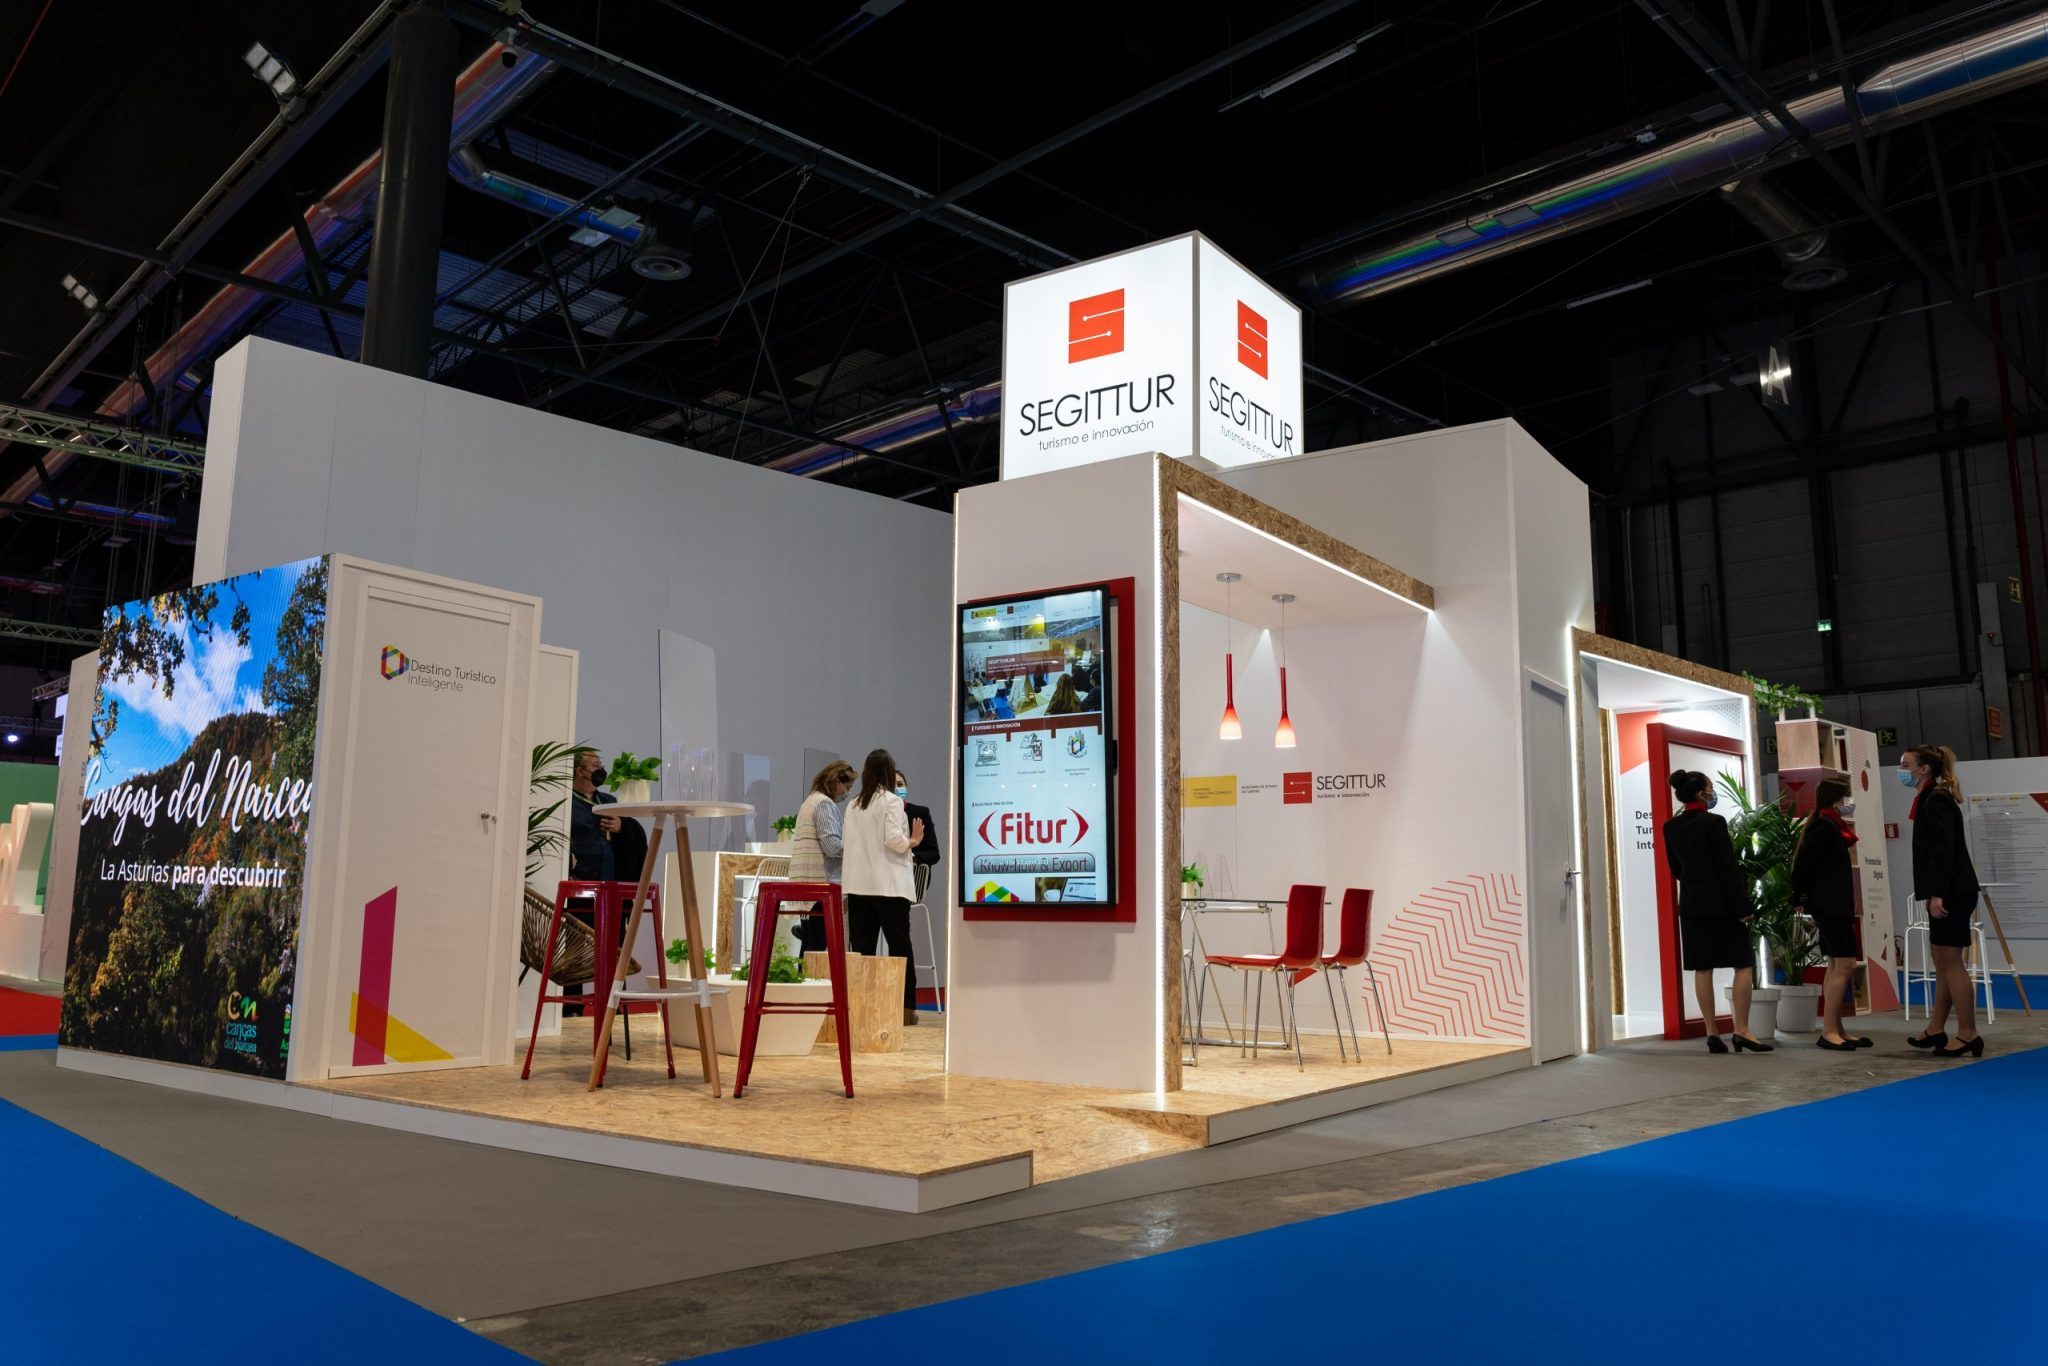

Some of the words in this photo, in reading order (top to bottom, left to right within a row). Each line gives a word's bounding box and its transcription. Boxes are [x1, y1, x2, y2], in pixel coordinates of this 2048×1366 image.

[1020, 374, 1175, 436] SEGITTUR
[1209, 376, 1294, 456] SEGITTUR
[1039, 435, 1079, 451] turismo
[1082, 434, 1089, 443] e
[1092, 419, 1154, 440] innovación
[408, 674, 464, 692] Inteligente
[410, 659, 452, 677] Destino
[454, 667, 497, 685] Turístico
[1316, 773, 1386, 790] SEGITTUR
[81, 760, 163, 846] Cangas
[167, 748, 221, 828] del
[1000, 811, 1068, 845] Fitur
[1635, 811, 1654, 820] Des
[1636, 826, 1654, 834] Tur
[1637, 841, 1654, 850] Int
[101, 858, 115, 881] La
[118, 859, 169, 883] Asturias
[172, 864, 207, 890] para
[210, 860, 287, 888] descubrir
[1052, 856, 1089, 873] Export
